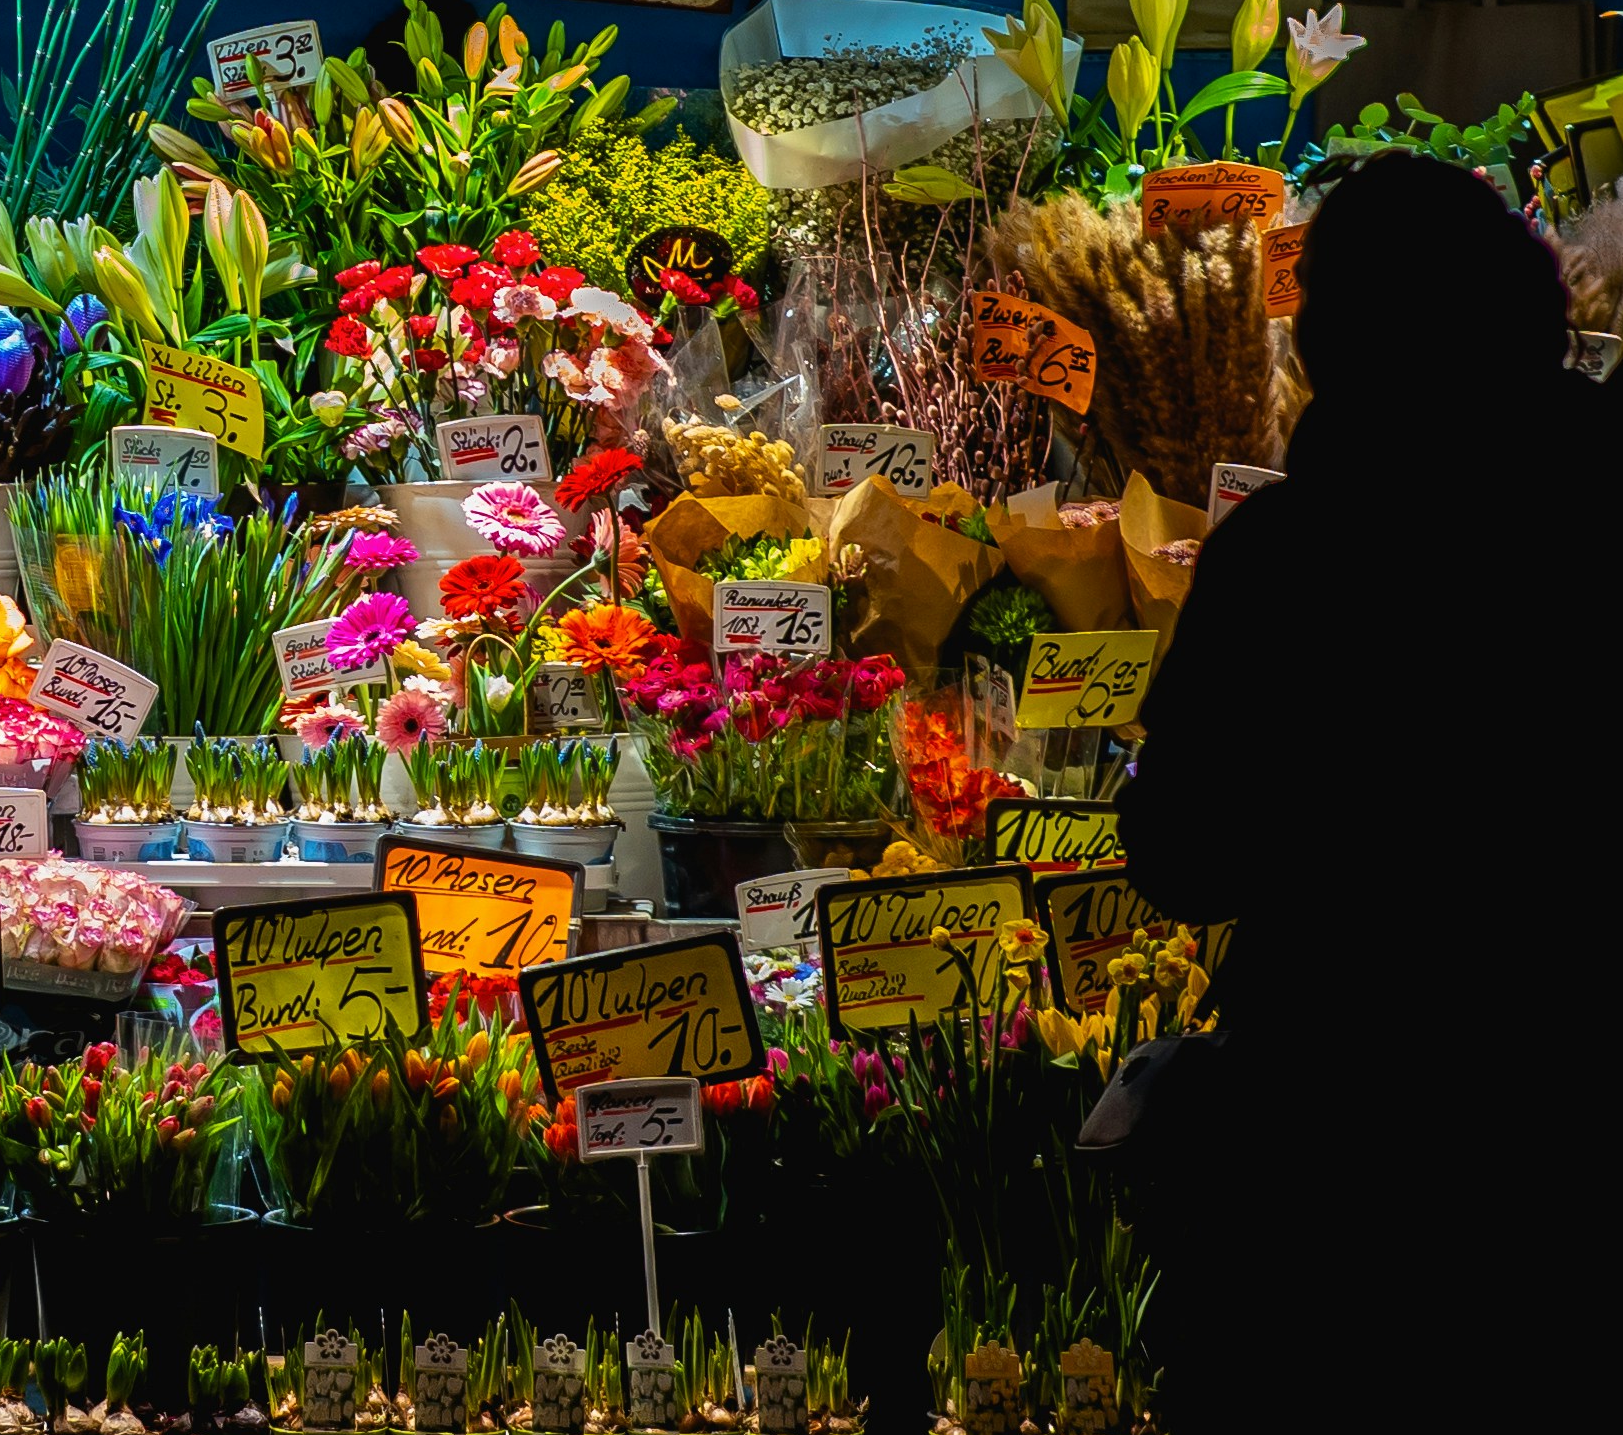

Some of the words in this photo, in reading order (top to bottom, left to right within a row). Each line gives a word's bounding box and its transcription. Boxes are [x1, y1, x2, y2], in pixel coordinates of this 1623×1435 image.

[151, 347, 173, 369] XL
[183, 357, 245, 393] Lilien
[438, 855, 537, 901] Rosen
[226, 916, 279, 967] 10
[277, 908, 382, 966] Tulpen
[537, 970, 589, 1033] 10
[591, 963, 708, 1024] Tulpen
